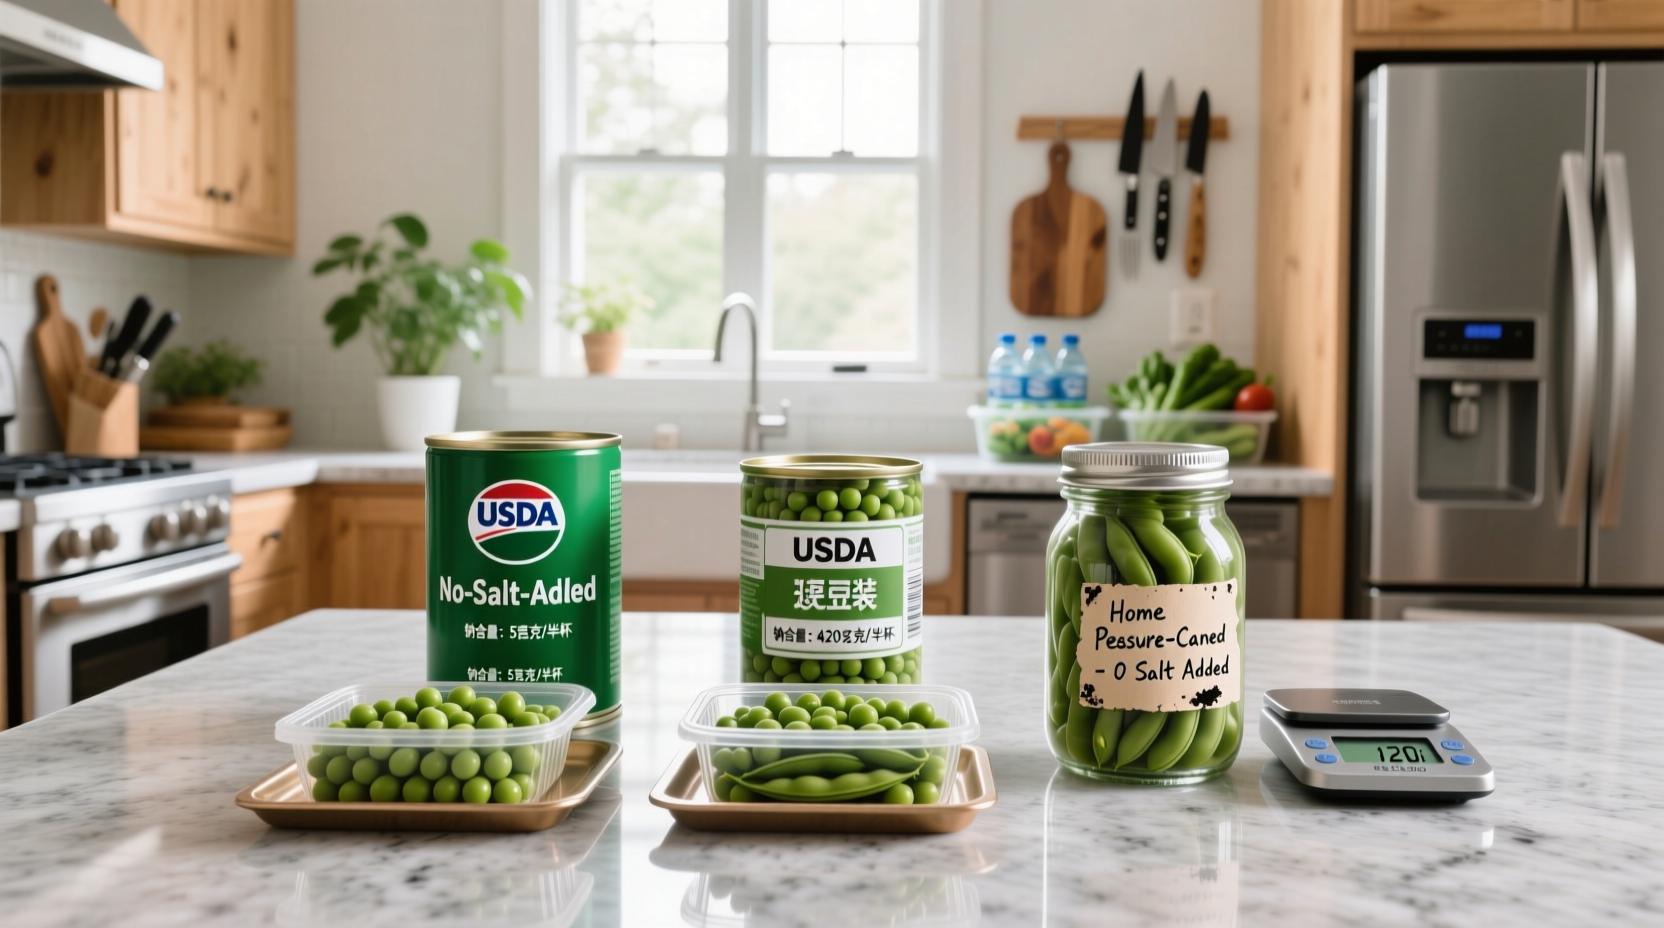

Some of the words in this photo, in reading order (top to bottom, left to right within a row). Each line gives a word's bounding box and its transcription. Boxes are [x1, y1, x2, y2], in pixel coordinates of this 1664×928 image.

[477, 502, 558, 527] USDA
[793, 537, 877, 563] USDA
[439, 574, 596, 606] No-Salt-Adled
[1110, 598, 1166, 624] Home
[1135, 659, 1175, 681] Salt
[1181, 654, 1229, 681] Added
